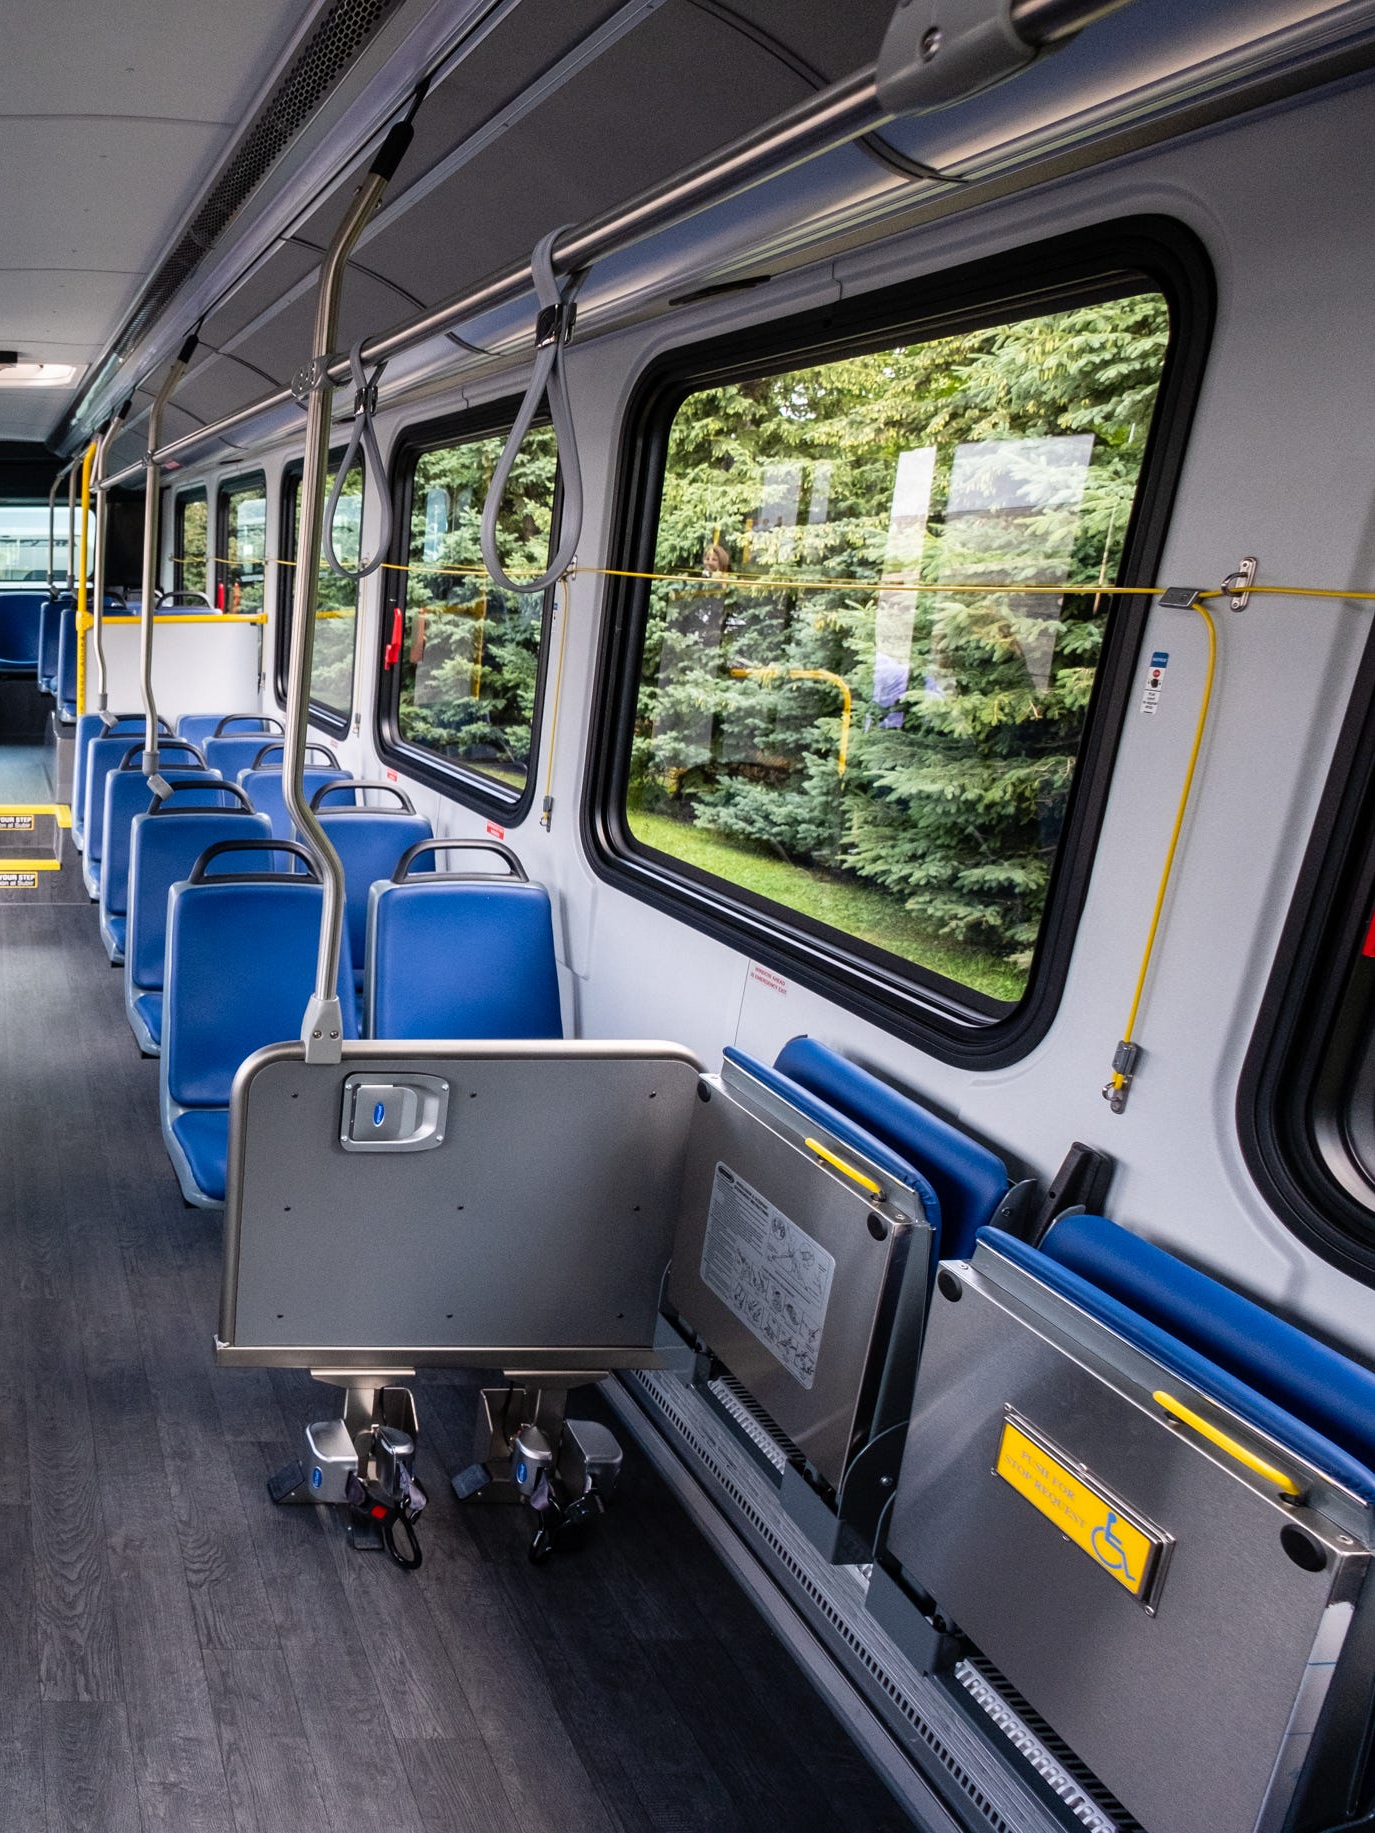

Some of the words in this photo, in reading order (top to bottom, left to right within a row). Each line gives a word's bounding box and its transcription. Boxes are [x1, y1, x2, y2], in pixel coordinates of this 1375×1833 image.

[1005, 1455, 1032, 1479] STOP
[1035, 1480, 1085, 1528] REQUEST
[1022, 1451, 1049, 1478] PUSH
[1052, 1477, 1076, 1501] FOR
